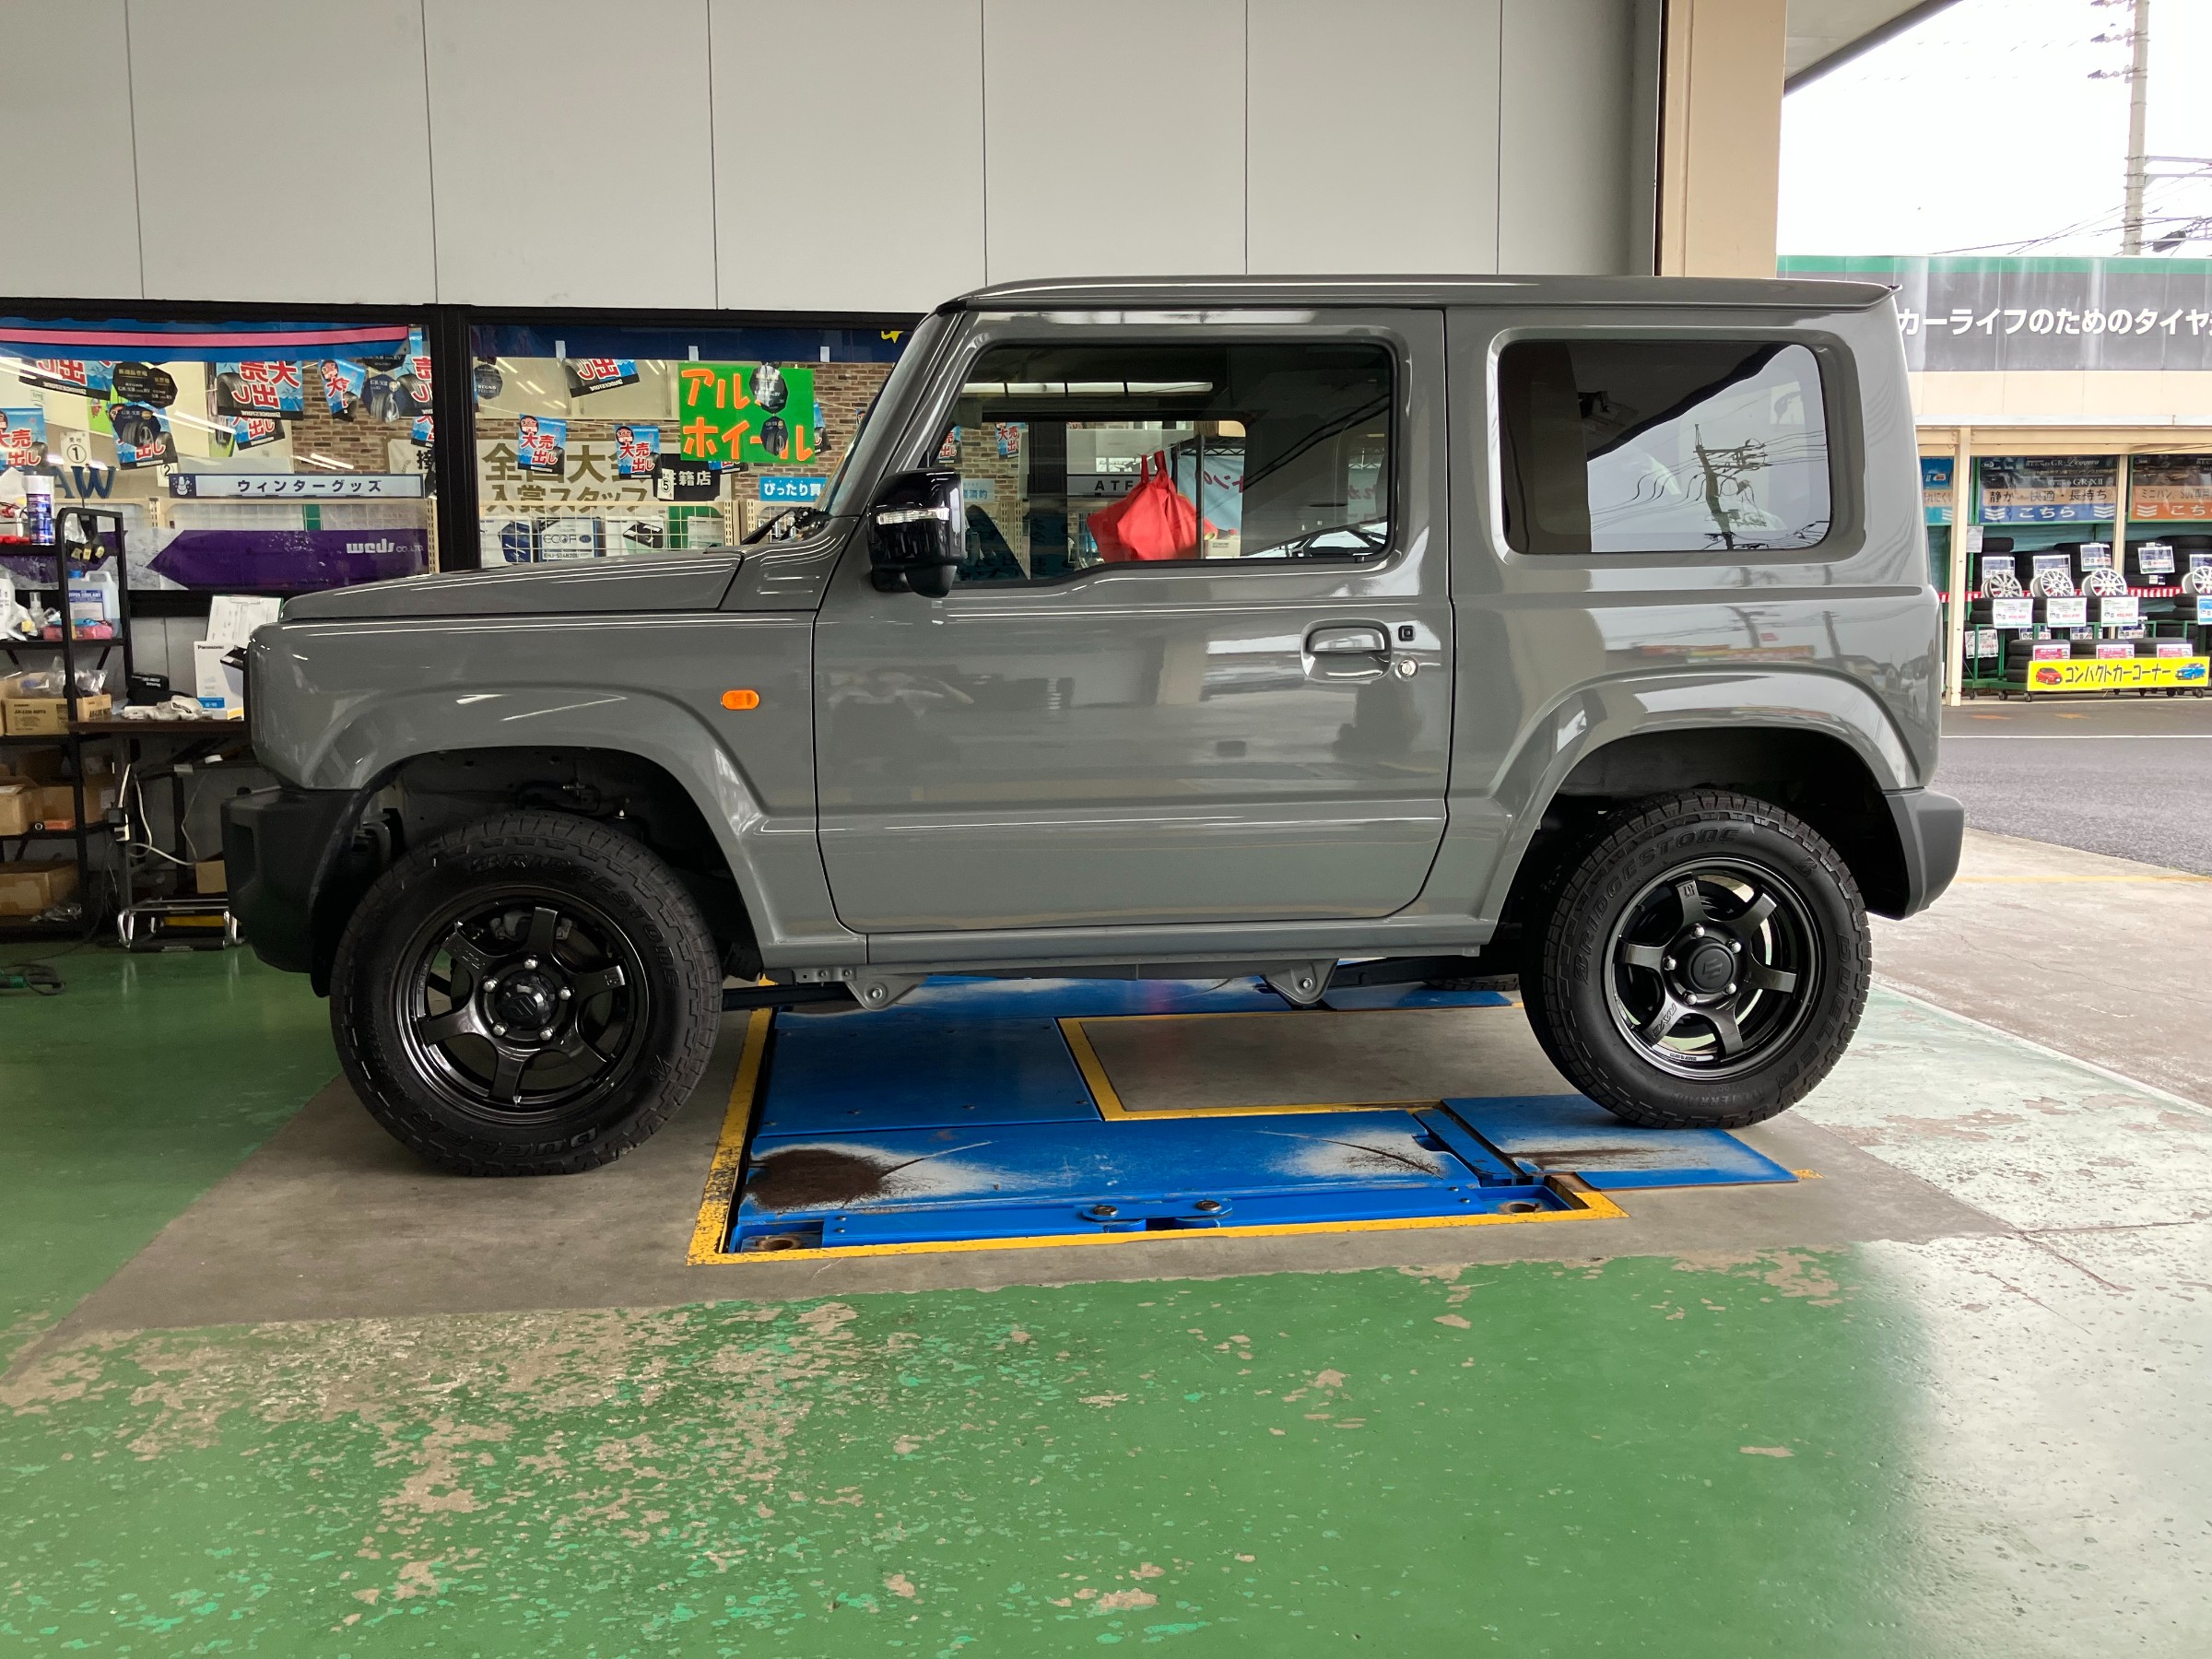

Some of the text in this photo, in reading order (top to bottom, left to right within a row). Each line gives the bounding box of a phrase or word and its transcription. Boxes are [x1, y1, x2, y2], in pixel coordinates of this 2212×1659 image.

[1898, 308, 2212, 335] カーライフのためのタイヤ
[237, 479, 382, 494] ウィンターグッズ
[2019, 506, 2076, 518] こちら
[346, 537, 395, 554] weds
[2065, 662, 2172, 685] コンパクトカーコーナー
[1572, 826, 1742, 986] BRIDGESTONE
